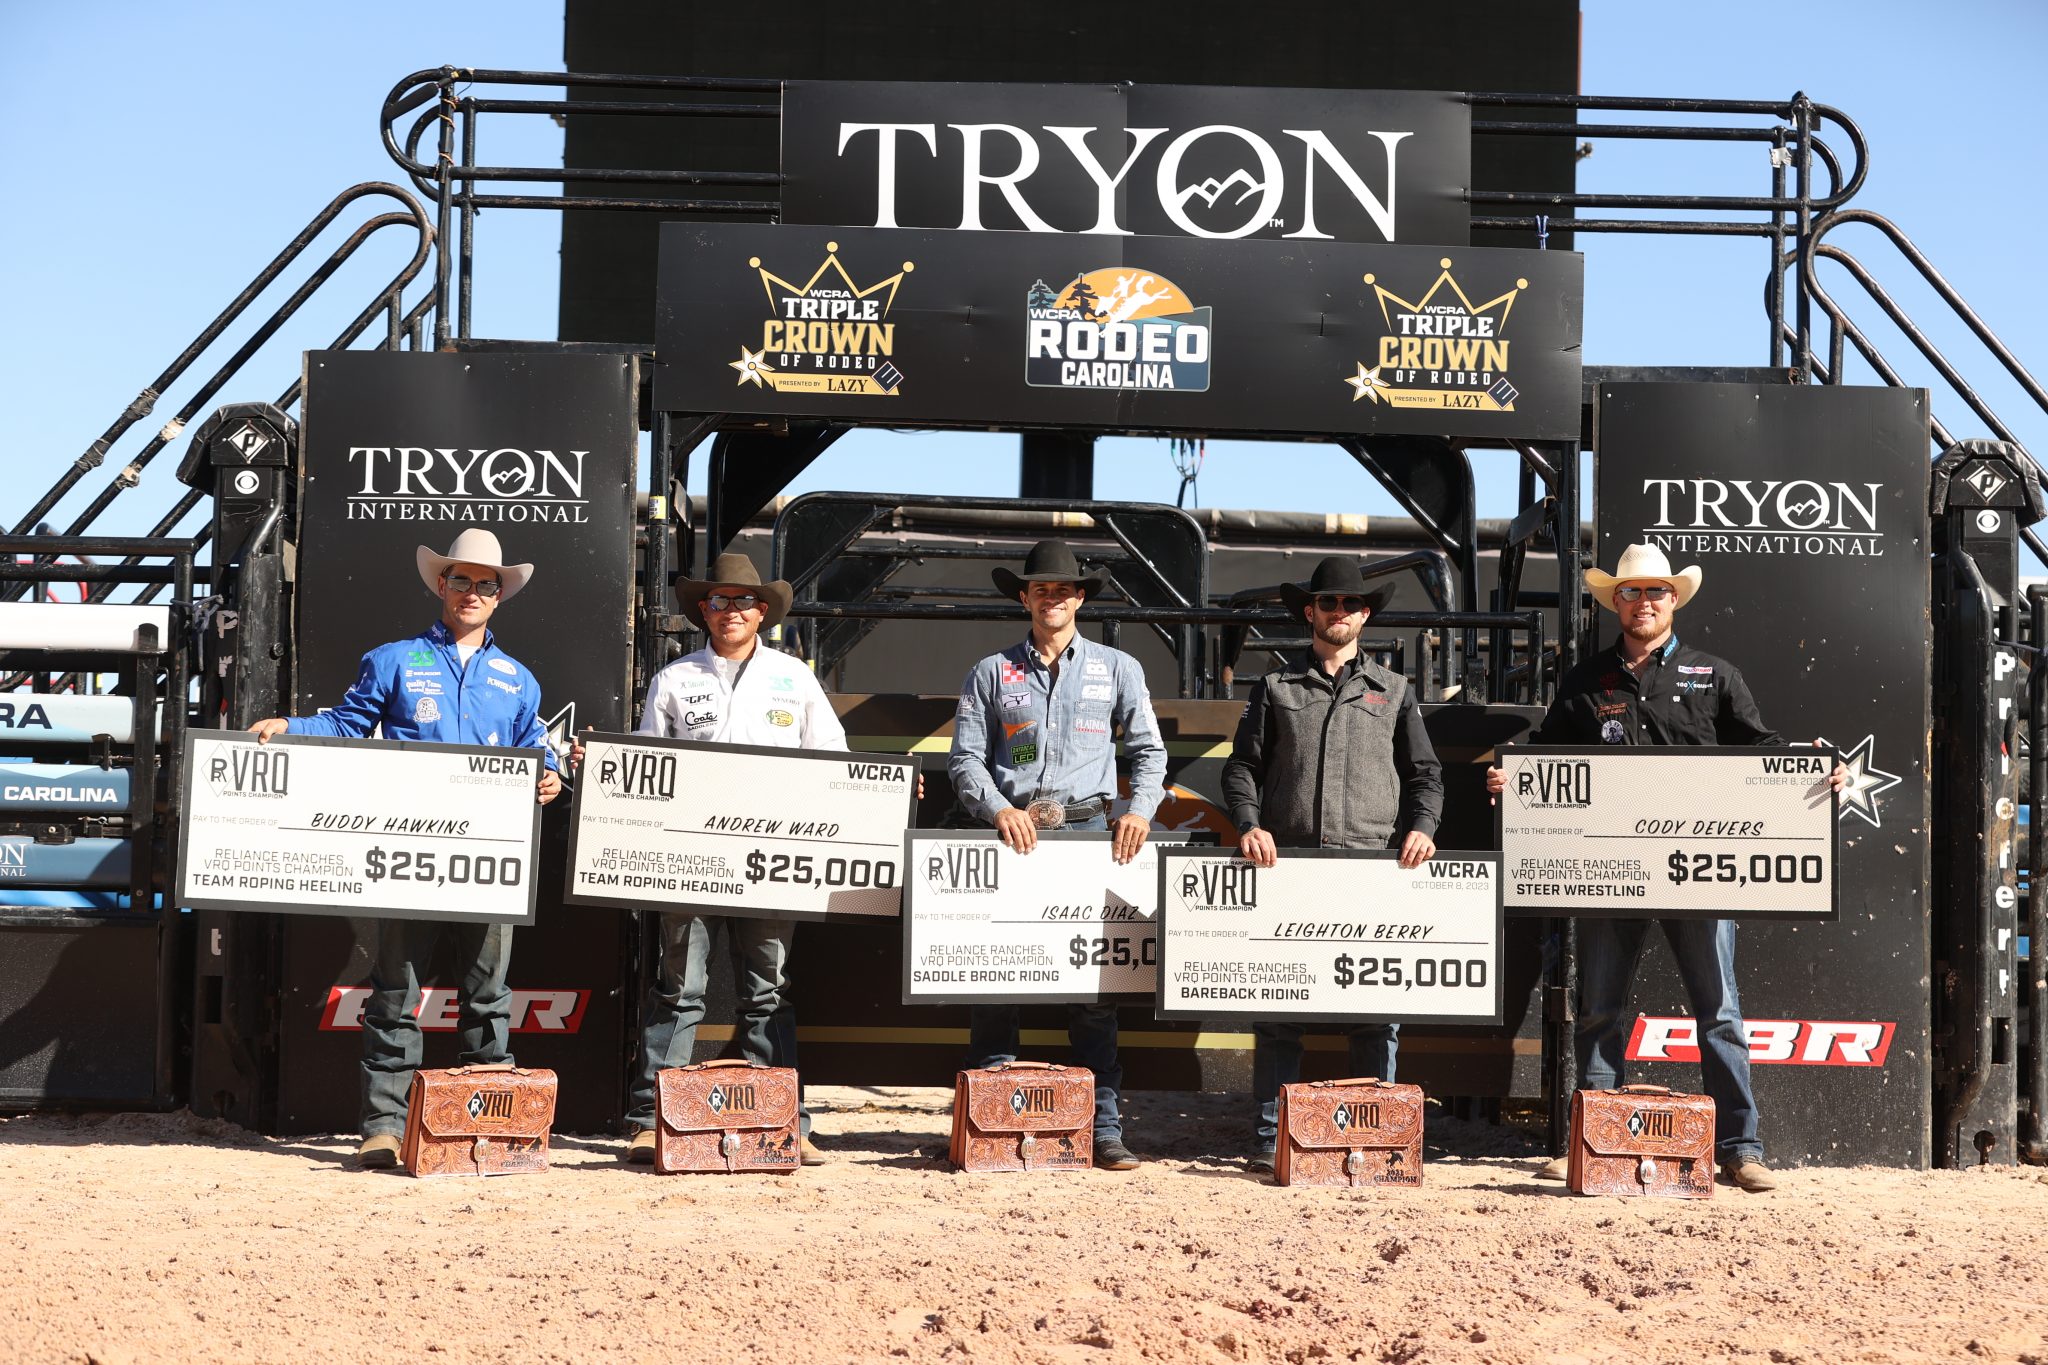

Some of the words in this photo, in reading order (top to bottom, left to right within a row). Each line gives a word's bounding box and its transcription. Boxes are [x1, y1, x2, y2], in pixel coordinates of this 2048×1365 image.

[838, 122, 1413, 242] TRYON
[810, 290, 851, 298] WCRA
[782, 298, 879, 320] TRIPLE
[1030, 309, 1082, 320] WCRA
[1425, 306, 1466, 314] WCRA
[1397, 314, 1494, 337] TRIPLE
[764, 320, 895, 356] CROWN
[1029, 320, 1208, 363] RODEO
[781, 355, 800, 367] OF
[816, 356, 875, 369] RODEO
[1379, 336, 1510, 372] CROWN
[1061, 361, 1174, 388] CAROLINA
[1396, 371, 1416, 383] OF
[1431, 371, 1490, 385] RODEO
[827, 378, 868, 392] LAZY
[1443, 394, 1483, 408] LAZY
[348, 447, 590, 498] TRYON
[347, 503, 589, 523] INTERNATIONAL
[1643, 479, 1883, 530] TRYON
[1643, 536, 1883, 557] INTERNATIONAL
[0, 704, 52, 729] RA
[468, 756, 529, 775] WCRA
[1014, 754, 1035, 764] LED
[1762, 758, 1824, 773] WCRA
[233, 750, 289, 796] VRQ
[450, 775, 492, 784] OCTOBER
[495, 778, 503, 786] 8,
[505, 779, 528, 787] 2023
[622, 753, 676, 799] VRQ
[848, 764, 905, 782] WCRA
[1746, 777, 1787, 785] OCTOBER
[1791, 777, 1798, 786] 8,
[1801, 777, 1824, 785] 2023
[830, 782, 870, 791] OCTOBER
[872, 784, 879, 792] 8,
[882, 785, 904, 793] 2023
[1537, 763, 1591, 805] VRQ
[4, 786, 118, 803] CAROLINA
[311, 813, 377, 830] BUDDY
[384, 817, 470, 835] HAWKINS
[627, 819, 652, 827] ORDER
[704, 815, 782, 834] ANDREW
[789, 822, 840, 837] WARD
[1635, 819, 1686, 835] CODY
[1693, 821, 1764, 836] DEVERS
[215, 849, 279, 862] RELIANCE
[283, 852, 344, 865] RANCHES
[603, 848, 663, 863] RELIANCE
[667, 853, 726, 866] RANCHES
[1521, 859, 1579, 869] RELIANCE
[1584, 860, 1641, 870] RANCHES
[204, 859, 230, 871] VRQ
[234, 861, 280, 873] POINTS
[285, 863, 353, 877] CHAMPION
[365, 846, 521, 887] $25,000
[592, 858, 616, 870] VRQ
[621, 861, 665, 873] POINTS
[669, 864, 734, 878] CHAMPION
[746, 849, 895, 889] $25,000
[947, 848, 999, 890] VRQ
[1429, 862, 1489, 878] WCRA
[1512, 869, 1535, 880] VRQ
[1540, 870, 1582, 880] POINTS
[1586, 870, 1650, 880] CHAMPION
[1668, 850, 1822, 887] $25,000
[193, 874, 233, 887] TEAM
[239, 877, 294, 890] ROPING
[300, 880, 362, 893] HEELING
[580, 872, 619, 885] TEAM
[624, 875, 676, 890] ROPING
[681, 880, 744, 895] HEADING
[1202, 865, 1257, 908] VRQ
[1412, 881, 1453, 889] OCTOBER
[1456, 882, 1463, 890] 8,
[1466, 882, 1488, 890] 2023
[1517, 884, 1560, 895] STEER
[1565, 885, 1645, 896] WRESTLING
[1041, 906, 1093, 920] ISAAC
[1100, 906, 1139, 920] DIAZ
[1274, 923, 1367, 939] LEIGHTON
[1374, 924, 1434, 940] BERRY
[930, 945, 986, 955] RELIANCE
[991, 945, 1045, 955] RANCHES
[1069, 934, 1156, 971] $25,0
[921, 956, 944, 966] VRQ
[948, 956, 989, 966] POINTS
[993, 956, 1053, 966] CHAMPION
[1184, 962, 1244, 972] RELIANCE
[1248, 962, 1307, 973] RANCHES
[914, 971, 966, 982] SADDLE
[970, 971, 1015, 982] BRONC
[1020, 971, 1059, 982] RIDNG
[1174, 973, 1198, 983] VRQ
[1203, 973, 1247, 983] POINTS
[1251, 974, 1316, 984] CHAMPION
[1334, 953, 1487, 992] $25,000
[1182, 987, 1256, 999] BAREBACK
[1262, 988, 1309, 1000] RIDING
[1637, 1018, 1883, 1063] PBR
[1348, 1105, 1380, 1129] VRQ
